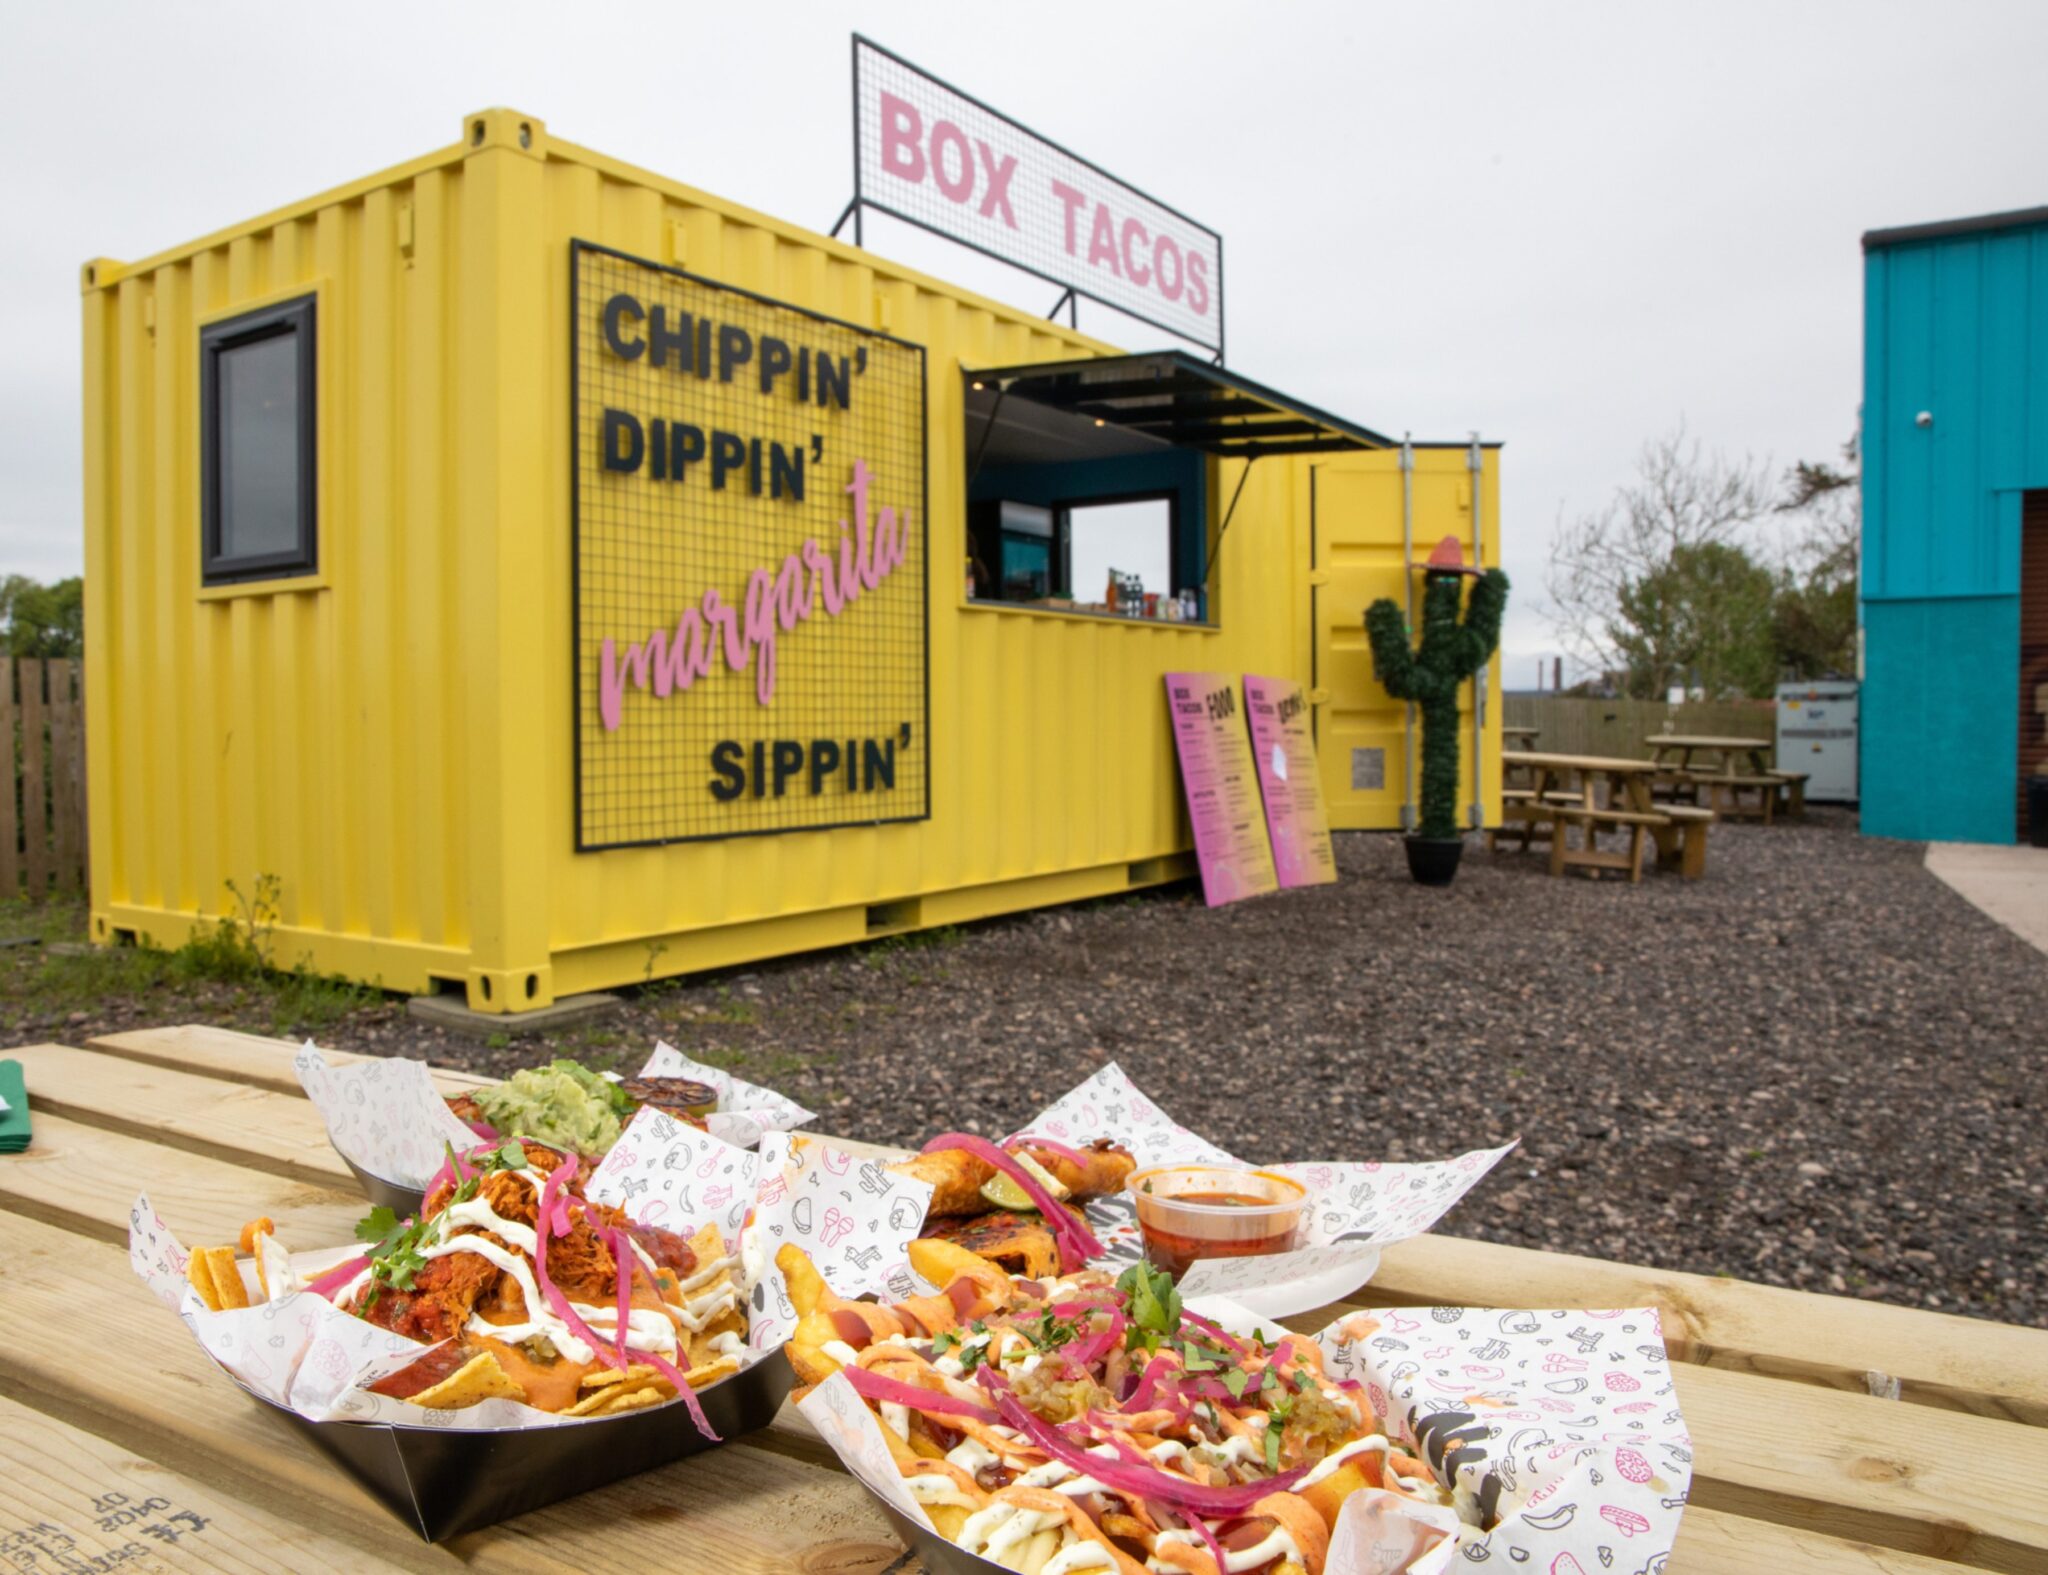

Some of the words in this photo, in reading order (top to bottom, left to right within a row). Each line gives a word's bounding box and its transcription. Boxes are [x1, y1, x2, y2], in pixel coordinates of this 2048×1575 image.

[880, 90, 1019, 231] BOX
[1051, 178, 1209, 317] TACOS
[603, 292, 868, 411] CHIPPIN'
[603, 407, 824, 502] DIPPIN'
[600, 458, 911, 732] margarita
[709, 721, 912, 801] SIPPIN'
